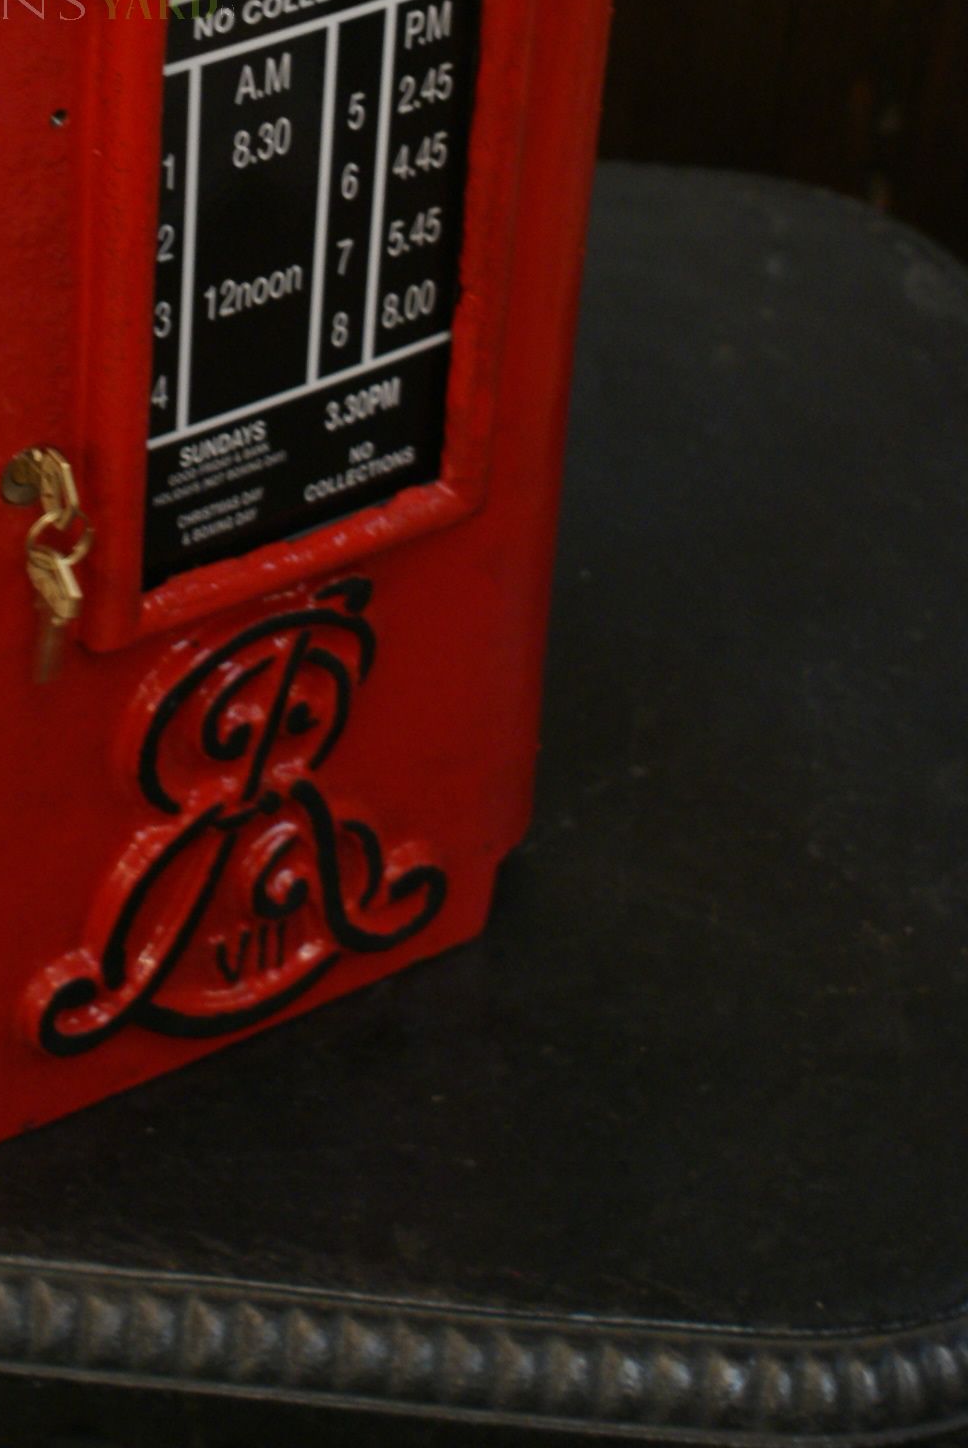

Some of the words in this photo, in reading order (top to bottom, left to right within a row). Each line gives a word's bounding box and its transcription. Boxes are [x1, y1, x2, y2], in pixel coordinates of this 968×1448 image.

[193, 6, 235, 41] NO
[397, 62, 454, 114] 2.45
[347, 91, 366, 131] 5
[232, 116, 293, 169] 8.30
[392, 131, 448, 181] 4.45
[162, 152, 176, 190] 1
[341, 162, 360, 200] 6
[156, 224, 175, 263] 2
[386, 207, 443, 257] 5.45
[336, 238, 355, 276] 7
[203, 264, 304, 321] 12noon
[382, 279, 436, 329] 8.00
[153, 301, 173, 338] 3
[331, 311, 349, 348] 8
[150, 375, 169, 410] 4
[178, 419, 268, 469] SUNDAYS
